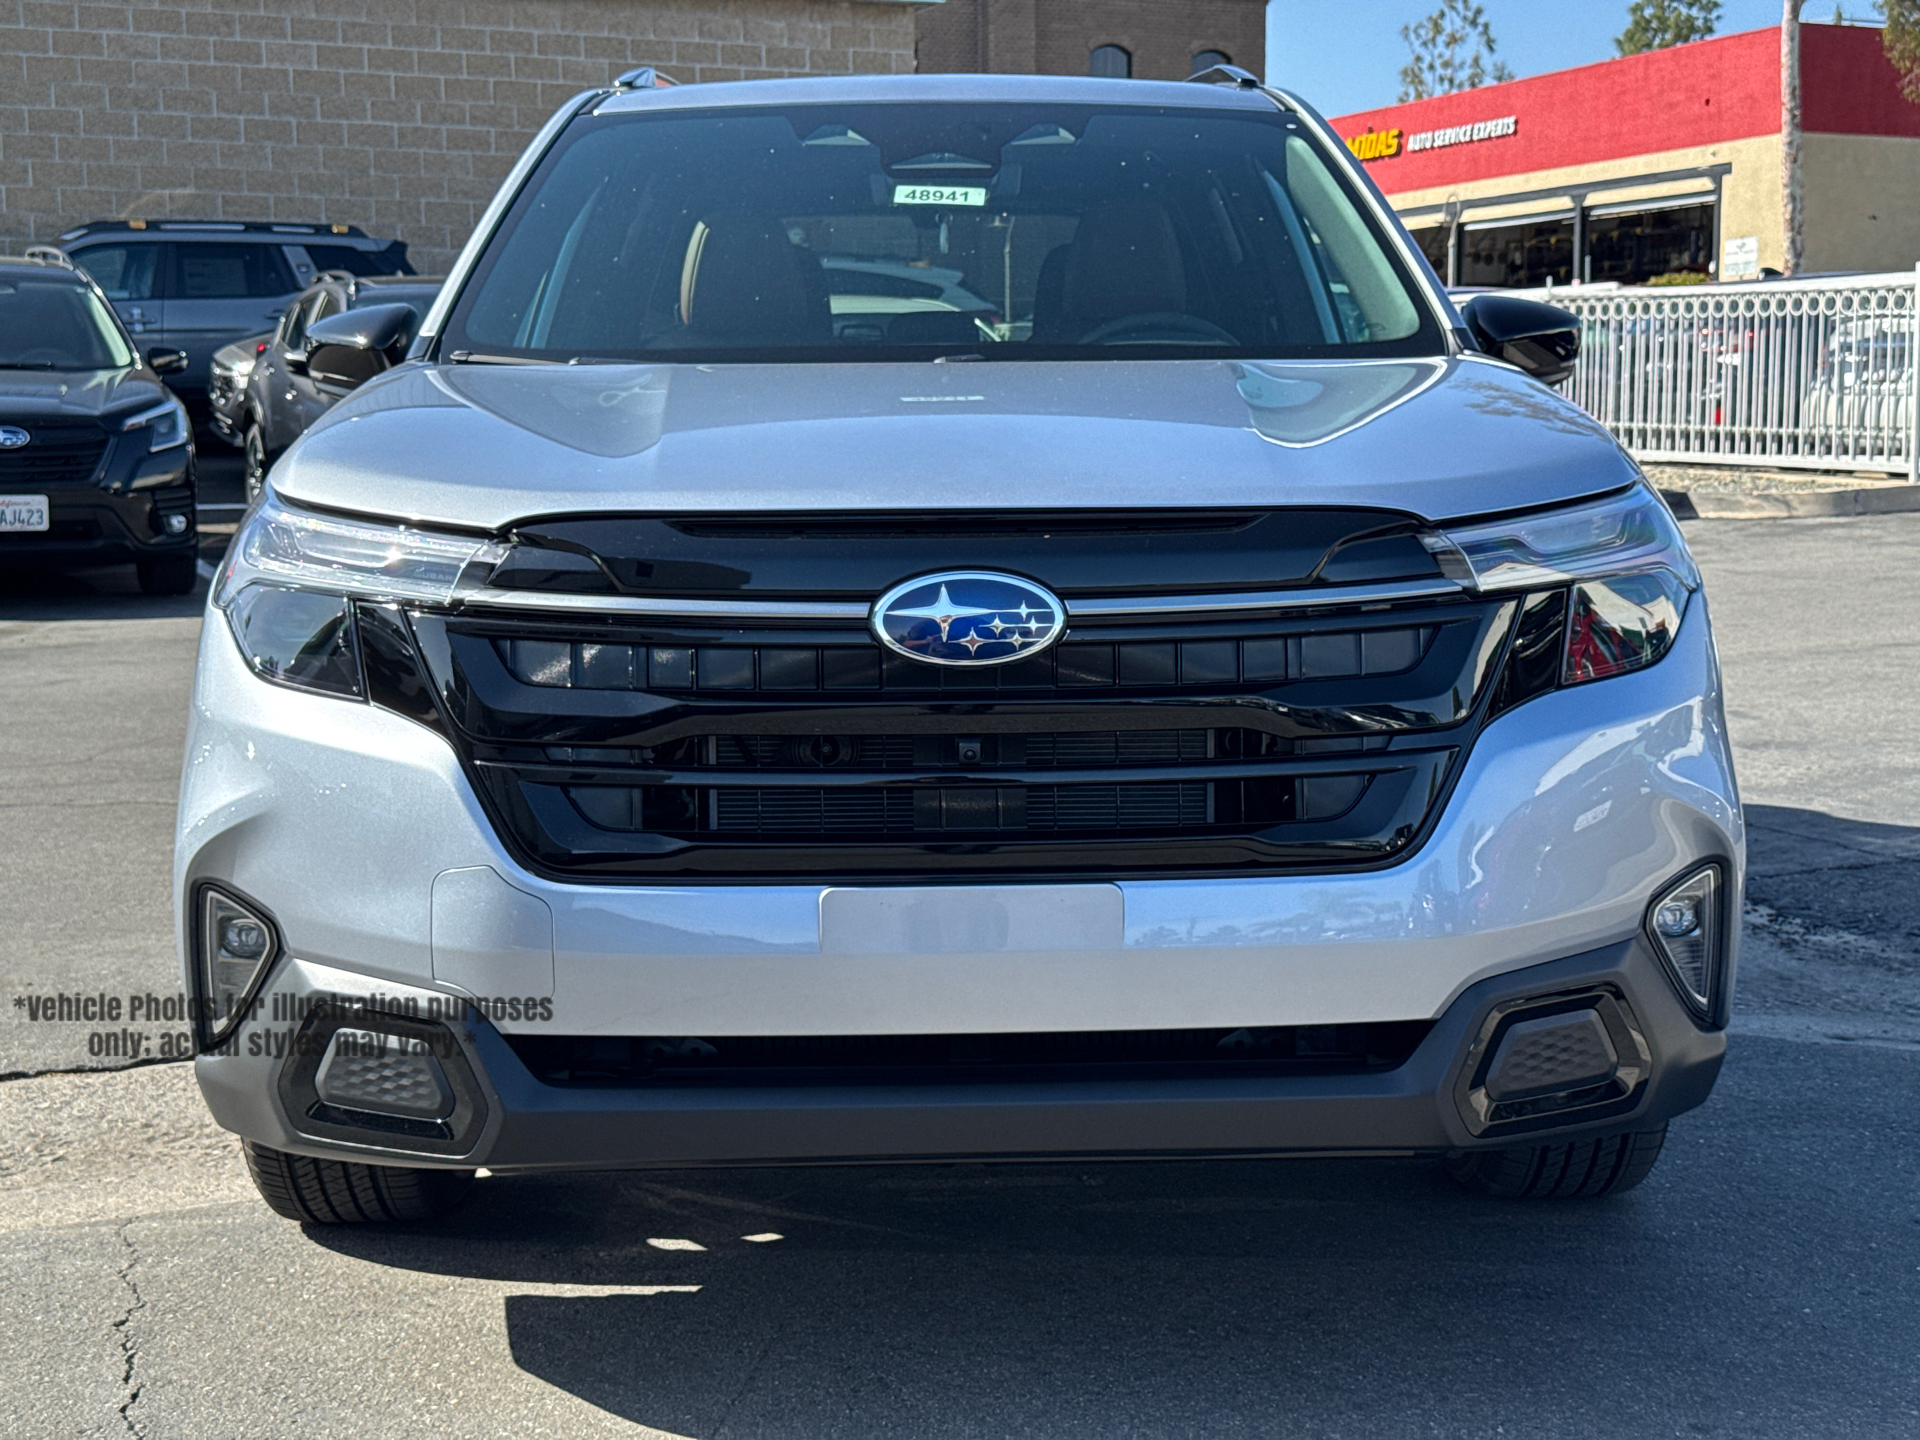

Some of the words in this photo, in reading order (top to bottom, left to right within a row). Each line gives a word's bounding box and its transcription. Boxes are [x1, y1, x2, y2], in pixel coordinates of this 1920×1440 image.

[1407, 131, 1433, 152] AUTO
[1433, 123, 1473, 148] SERVICE
[1472, 114, 1516, 141] EXPERTS
[904, 189, 970, 203] 48941
